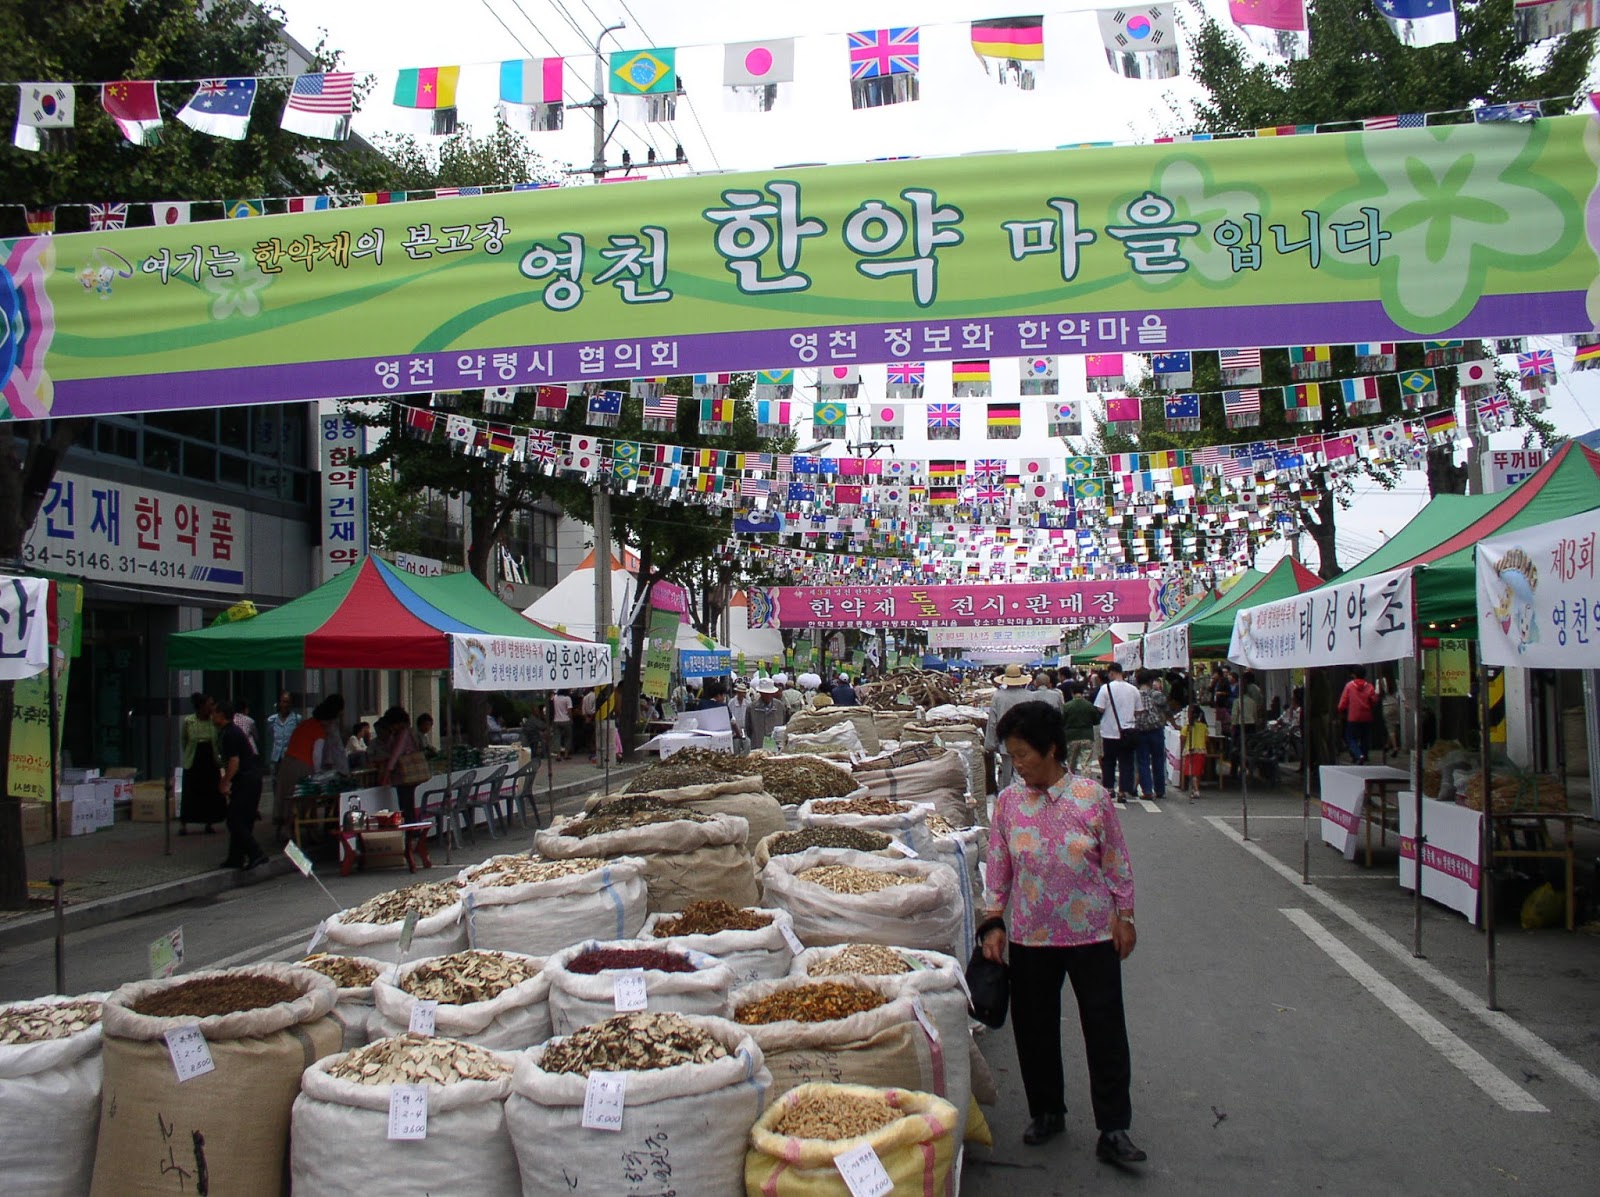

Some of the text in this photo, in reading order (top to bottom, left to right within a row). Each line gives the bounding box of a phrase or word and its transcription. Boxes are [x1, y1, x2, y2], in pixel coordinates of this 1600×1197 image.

[141, 216, 512, 285] 여기는 한약재의 본고장
[518, 226, 674, 312] 영천
[789, 313, 1169, 363] 영천 정보화 한약마을
[374, 341, 679, 390] 영천 약령시 협의회
[1494, 451, 1543, 470] 뚜꺼비
[1550, 532, 1596, 583] 제3회
[808, 596, 895, 618] 한약재
[908, 590, 942, 617] 도로
[1299, 578, 1406, 655] 태성약초
